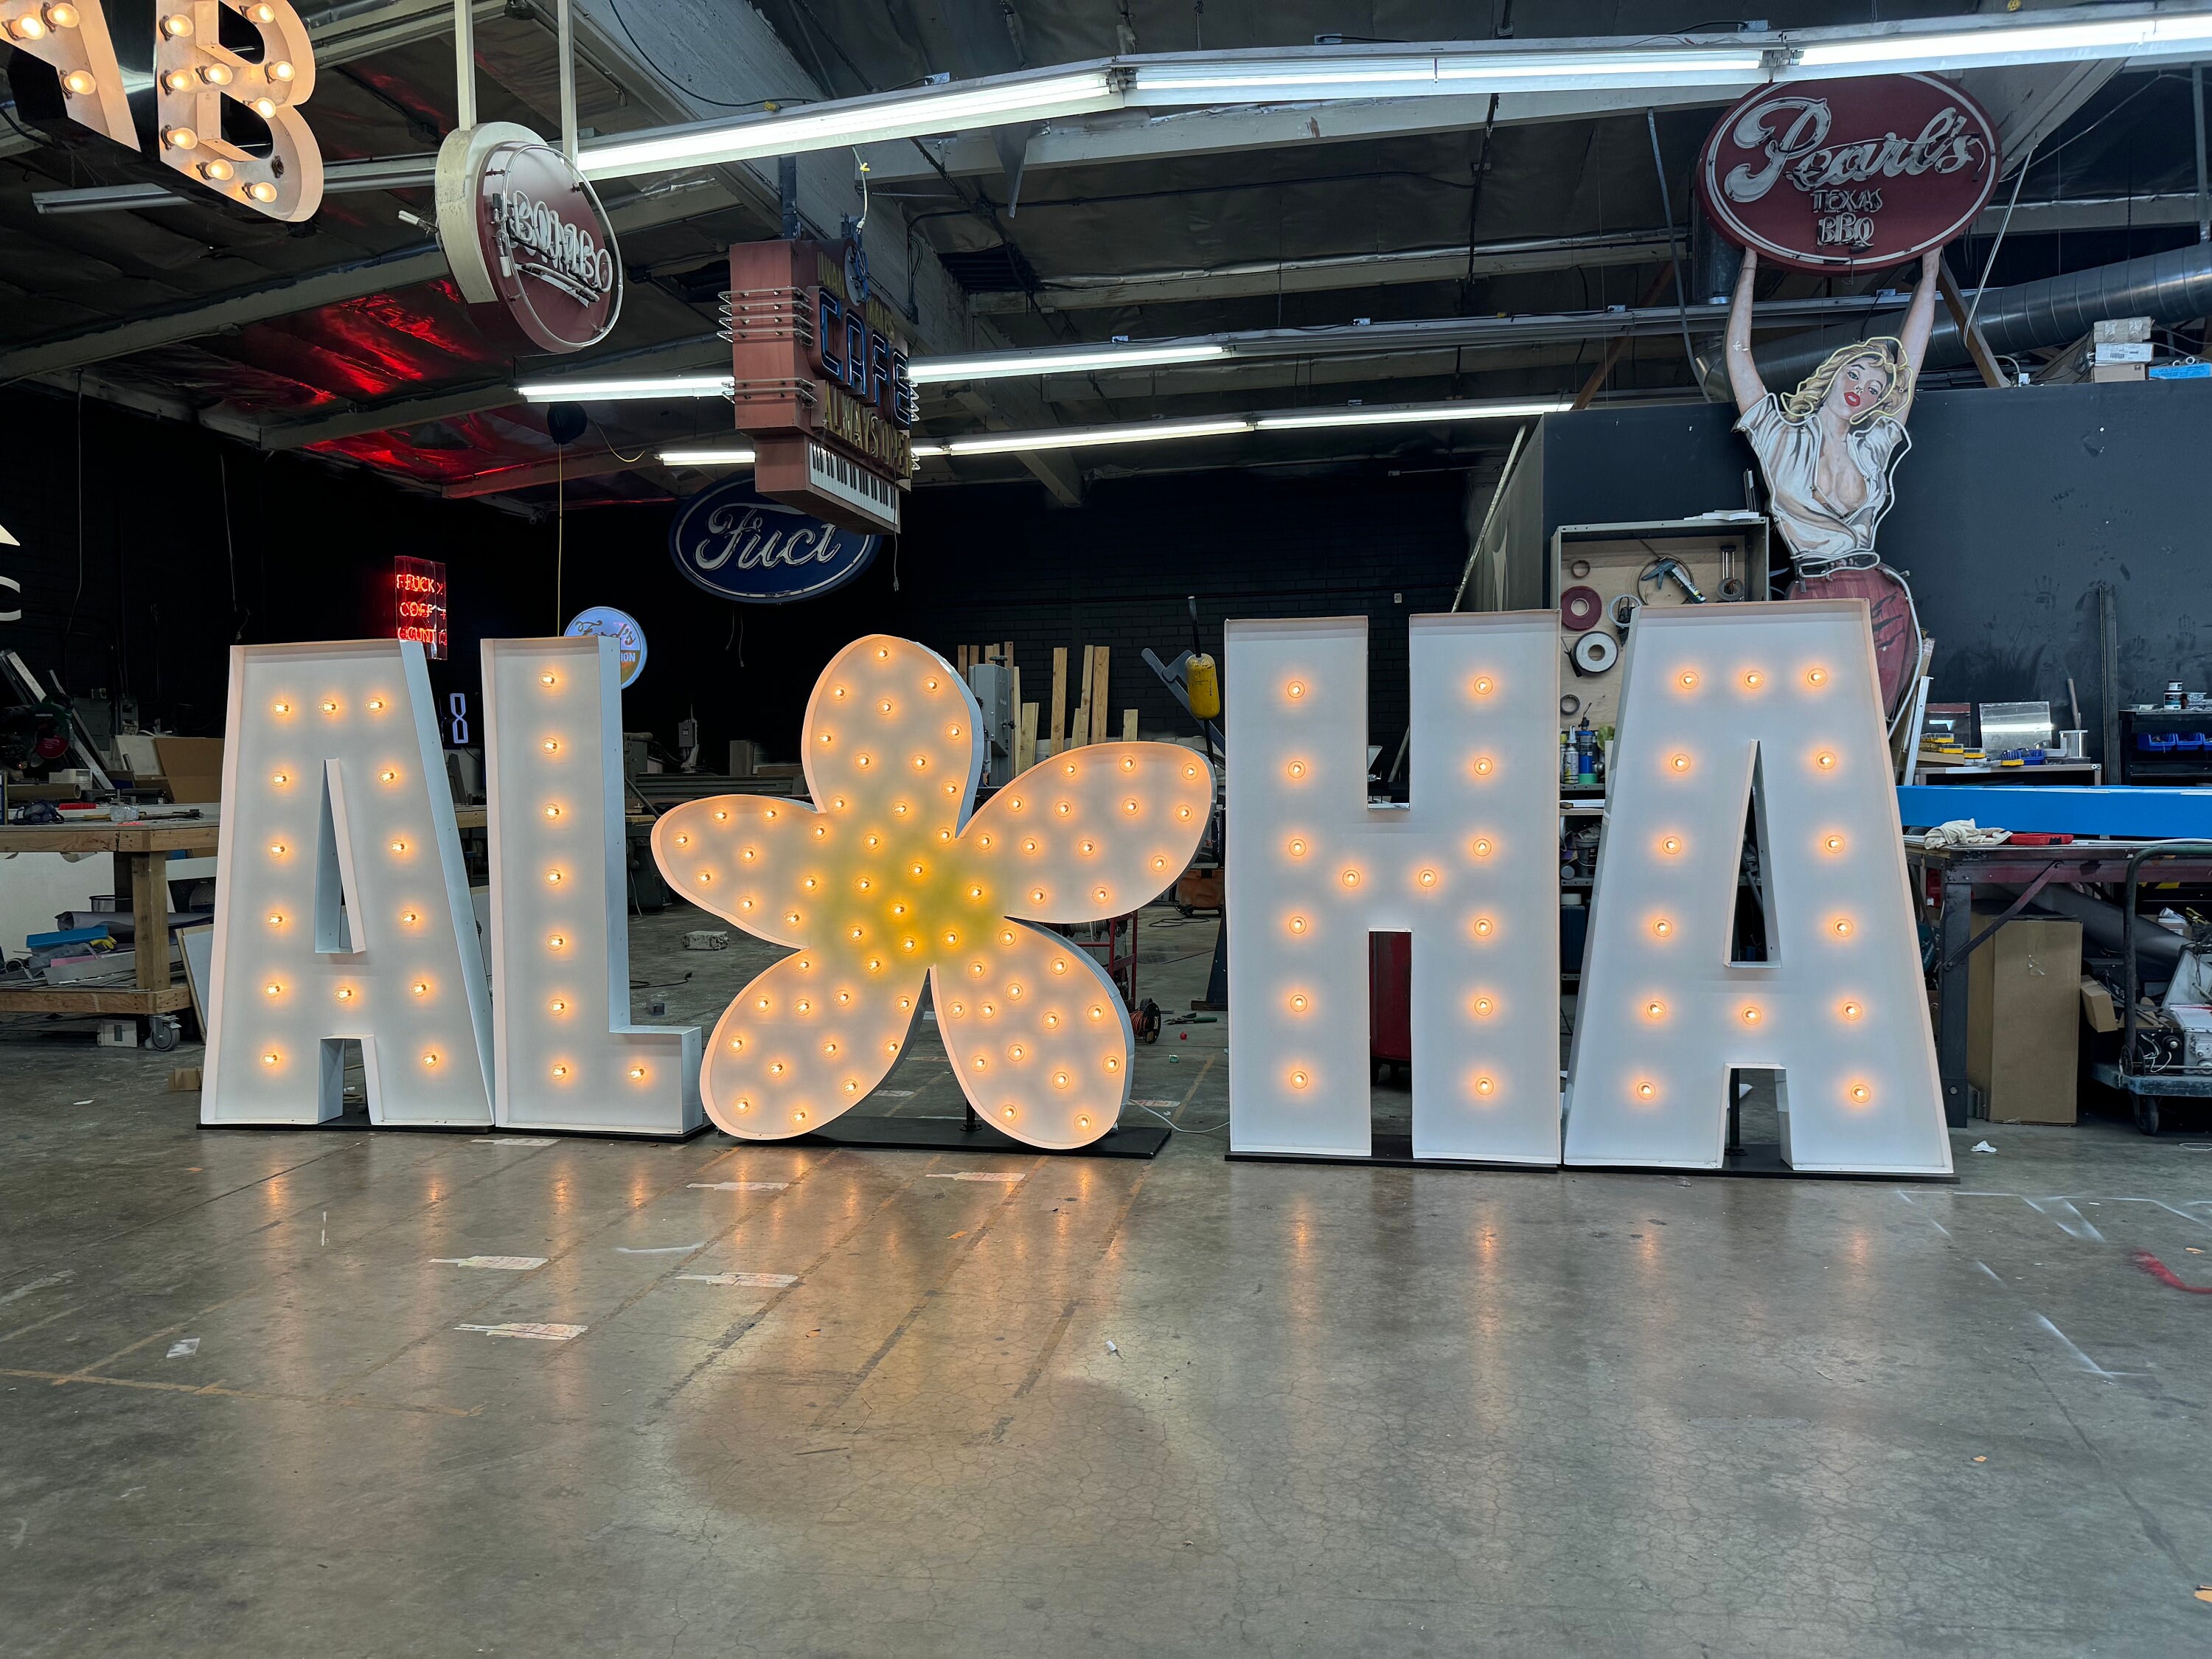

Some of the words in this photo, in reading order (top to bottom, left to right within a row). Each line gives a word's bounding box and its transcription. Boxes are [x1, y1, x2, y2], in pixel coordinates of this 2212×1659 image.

[1724, 97, 1979, 203] Pearl's
[1810, 188, 1883, 212] TEXAS
[1817, 212, 1874, 247] BBQ
[815, 287, 912, 431] CAFE
[824, 380, 879, 459] ALWAYS
